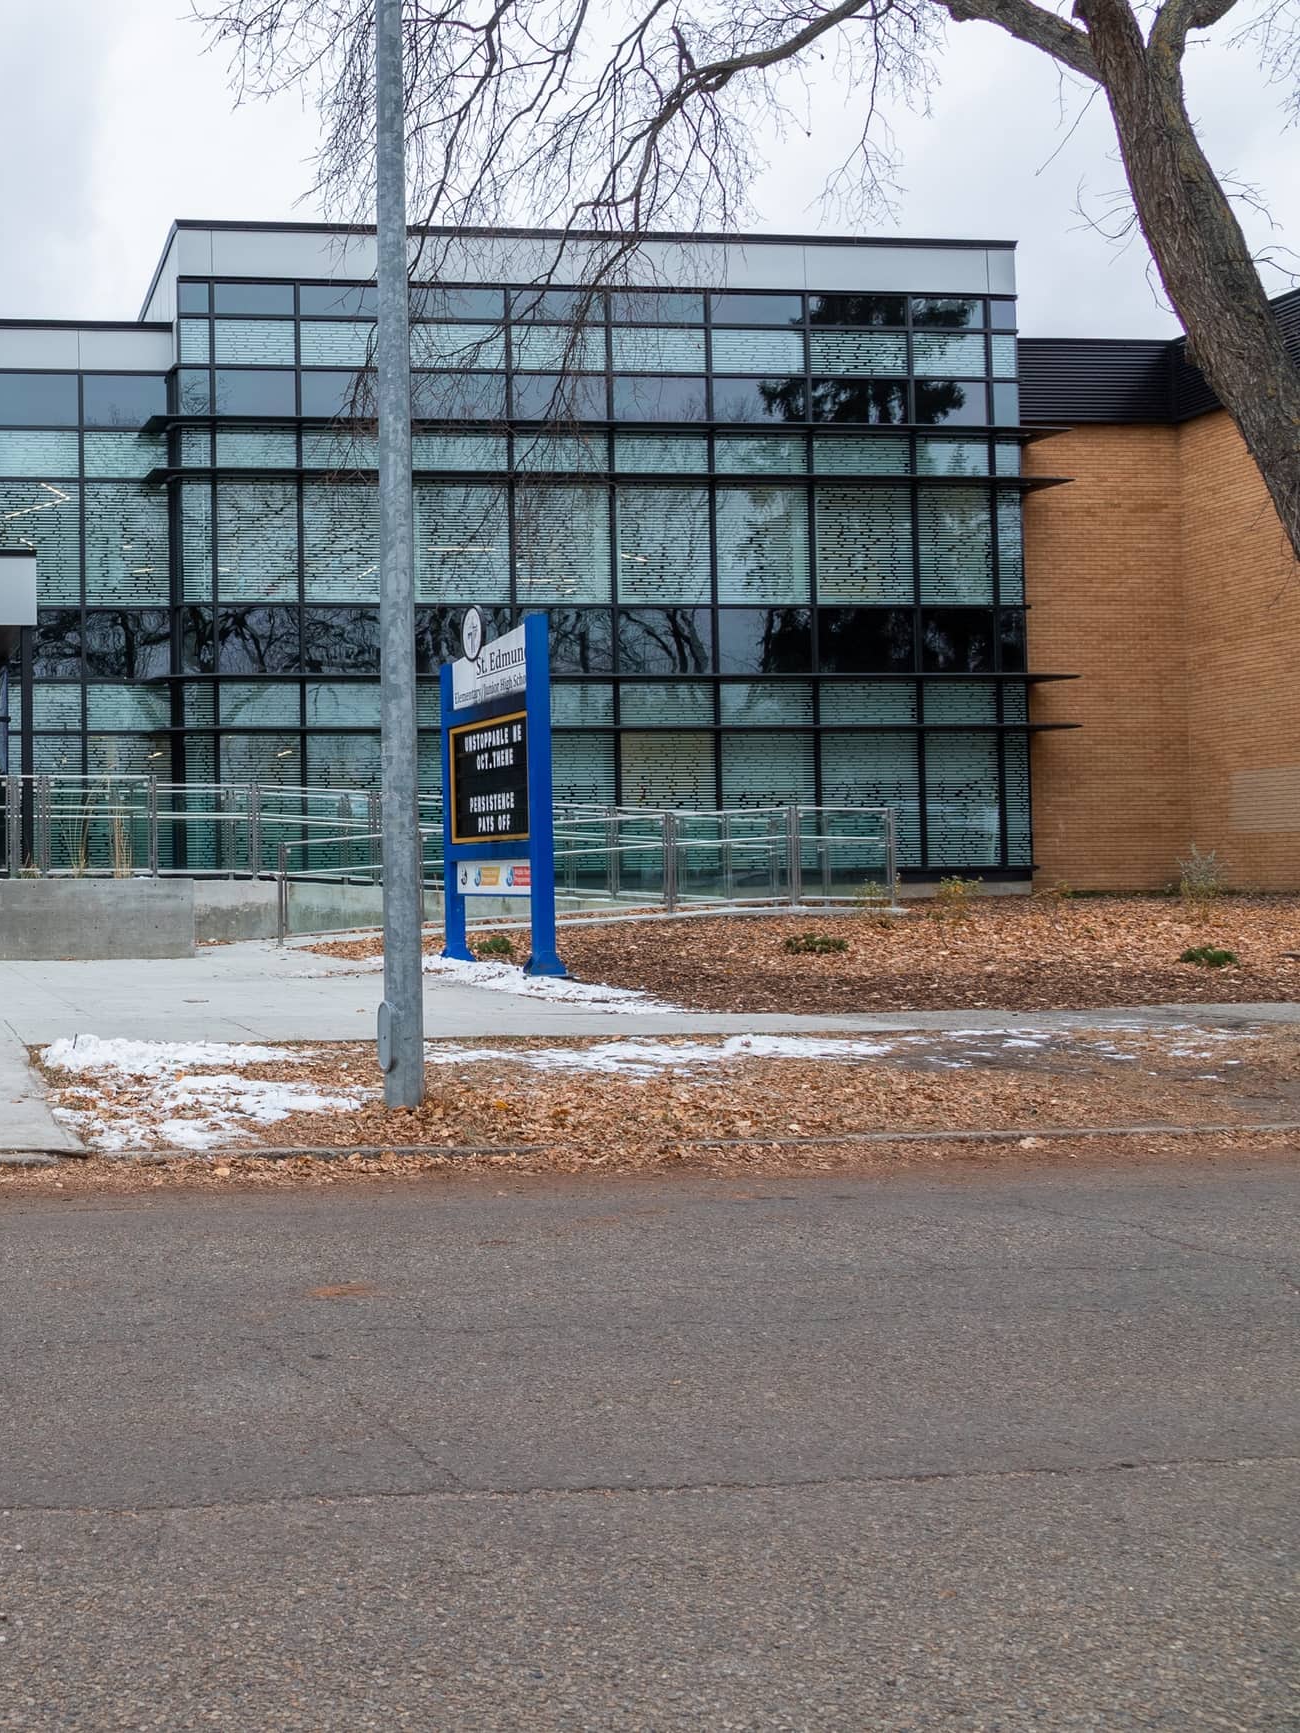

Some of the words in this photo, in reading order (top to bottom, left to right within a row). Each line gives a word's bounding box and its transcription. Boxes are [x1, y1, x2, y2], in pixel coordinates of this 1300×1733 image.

[476, 656, 488, 676] St.
[489, 647, 525, 671] Edmun
[499, 675, 513, 692] High
[469, 791, 515, 813] PERSISTENCE
[478, 815, 494, 832] PAYS
[497, 814, 510, 831] OFF
